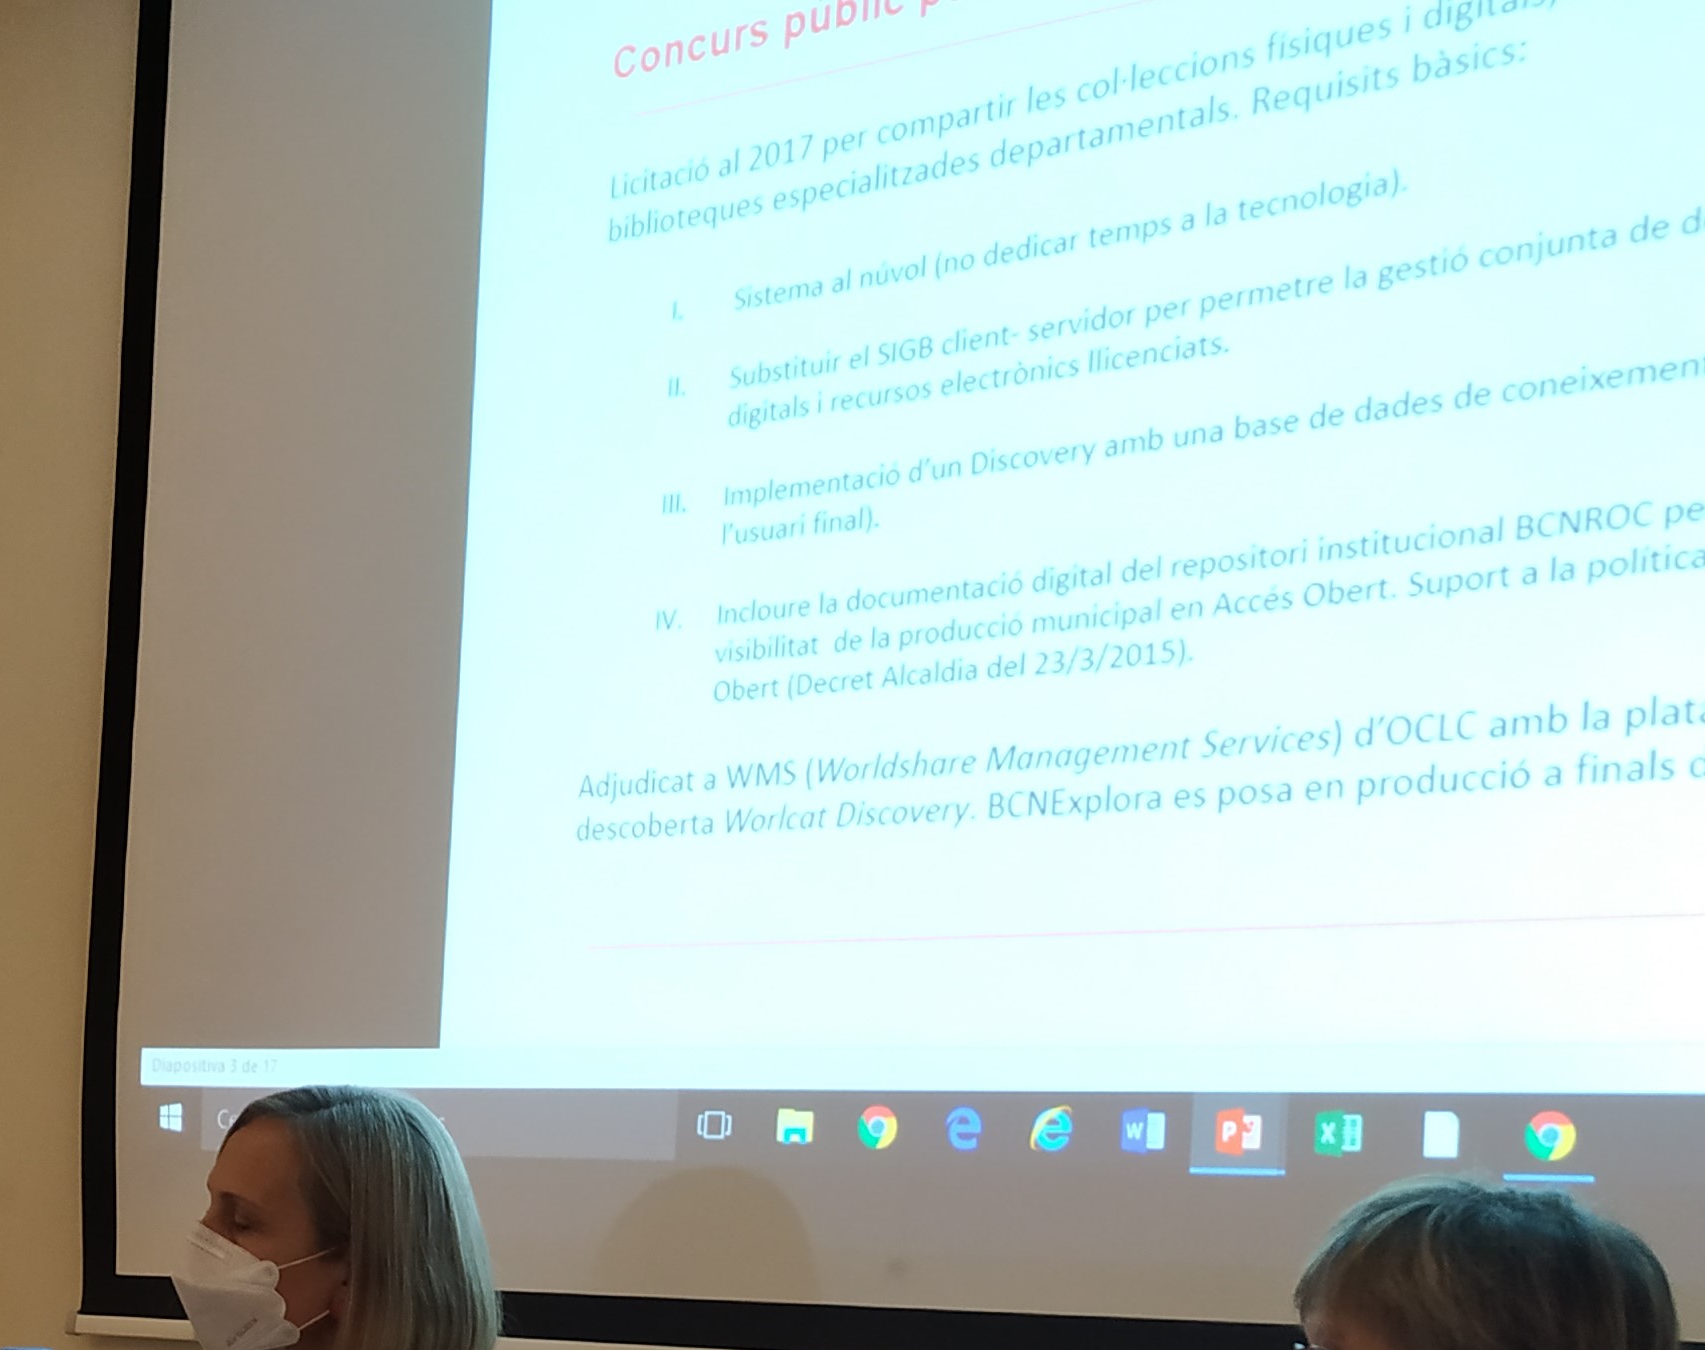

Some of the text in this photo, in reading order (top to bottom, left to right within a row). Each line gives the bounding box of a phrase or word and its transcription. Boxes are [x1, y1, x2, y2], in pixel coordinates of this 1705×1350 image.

[613, 20, 769, 78] Concurs
[608, 41, 1527, 243] biblioteques especialitzades departamentals. Requisits bàsics:
[610, 157, 710, 200] Licitació
[718, 147, 741, 178] al
[748, 133, 814, 172] 2017
[822, 130, 867, 164] per
[876, 93, 1016, 146] compartir
[1026, 84, 1067, 113] les
[1403, 6, 1412, 34] i
[734, 280, 824, 311] Sistema
[831, 267, 852, 294] al
[859, 254, 927, 288] núvol
[934, 251, 976, 280] (no
[982, 233, 1079, 268] dedicar
[1088, 216, 1172, 249] temps
[1180, 212, 1196, 233] a
[1205, 201, 1229, 227] la
[1237, 167, 1408, 222] tecnologia).
[730, 350, 842, 390] Substituir
[848, 344, 870, 370] el
[877, 335, 934, 367] SIGB
[940, 325, 1019, 356] client-
[1027, 304, 1136, 343] servidor
[1144, 298, 1191, 329] per
[1199, 274, 1334, 321] permetre
[1343, 264, 1368, 290] la
[1376, 246, 1470, 292] gestió
[1478, 227, 1618, 269] conjunta
[1629, 214, 1671, 244] de
[724, 462, 902, 509] Implementació
[970, 442, 1097, 477] Discovery
[1104, 426, 1165, 459] amb
[1172, 424, 1225, 449] una
[1233, 414, 1300, 441] base
[1308, 402, 1346, 431] de
[1353, 390, 1444, 424] dades
[1453, 381, 1492, 411] de
[1501, 355, 1705, 404] coneixemen
[727, 335, 1230, 431] digitals i recursos electrònics llicenciats.
[717, 598, 811, 625] Incloure
[818, 591, 839, 615] la
[845, 570, 1025, 613] documentació
[1031, 560, 1112, 598] digital
[1120, 554, 1163, 584] del
[1170, 538, 1308, 581] repositori
[1318, 515, 1505, 562] institucional
[1515, 500, 1654, 542] BCNROC
[813, 505, 880, 535] final).
[714, 634, 819, 664] visibilitat
[833, 628, 864, 654] de
[870, 626, 891, 650] la
[898, 613, 1024, 652] producció
[1031, 596, 1163, 634] municipal
[1169, 600, 1205, 622] en
[1212, 585, 1294, 616] Accés
[1302, 578, 1397, 609] Obert.
[1407, 565, 1510, 600] Suport
[1521, 565, 1539, 587] a
[1549, 555, 1577, 583] la
[712, 638, 1194, 704] Obert (Decret Alcaldia del 23/3/2015).
[575, 811, 715, 842] descoberta
[725, 804, 828, 834] Worlcat
[835, 800, 976, 829] Discovery.
[987, 783, 1163, 822] BCNExplora
[1173, 787, 1207, 810] es
[1217, 782, 1293, 815] posa
[1304, 778, 1345, 802] en
[1356, 758, 1532, 807] producció
[1542, 764, 1563, 788] a
[1575, 747, 1676, 785] finals
[578, 768, 695, 804] Adjudicat
[702, 772, 717, 792] a
[726, 759, 797, 790] WMS
[805, 749, 978, 791] (Worldshare
[985, 736, 1192, 776] Management
[1200, 718, 1343, 760] Services)
[1488, 701, 1570, 740] amb
[1580, 698, 1611, 733] la
[151, 1057, 225, 1074] Diapositiva
[241, 1059, 258, 1073] de
[1221, 1120, 1237, 1142] P
